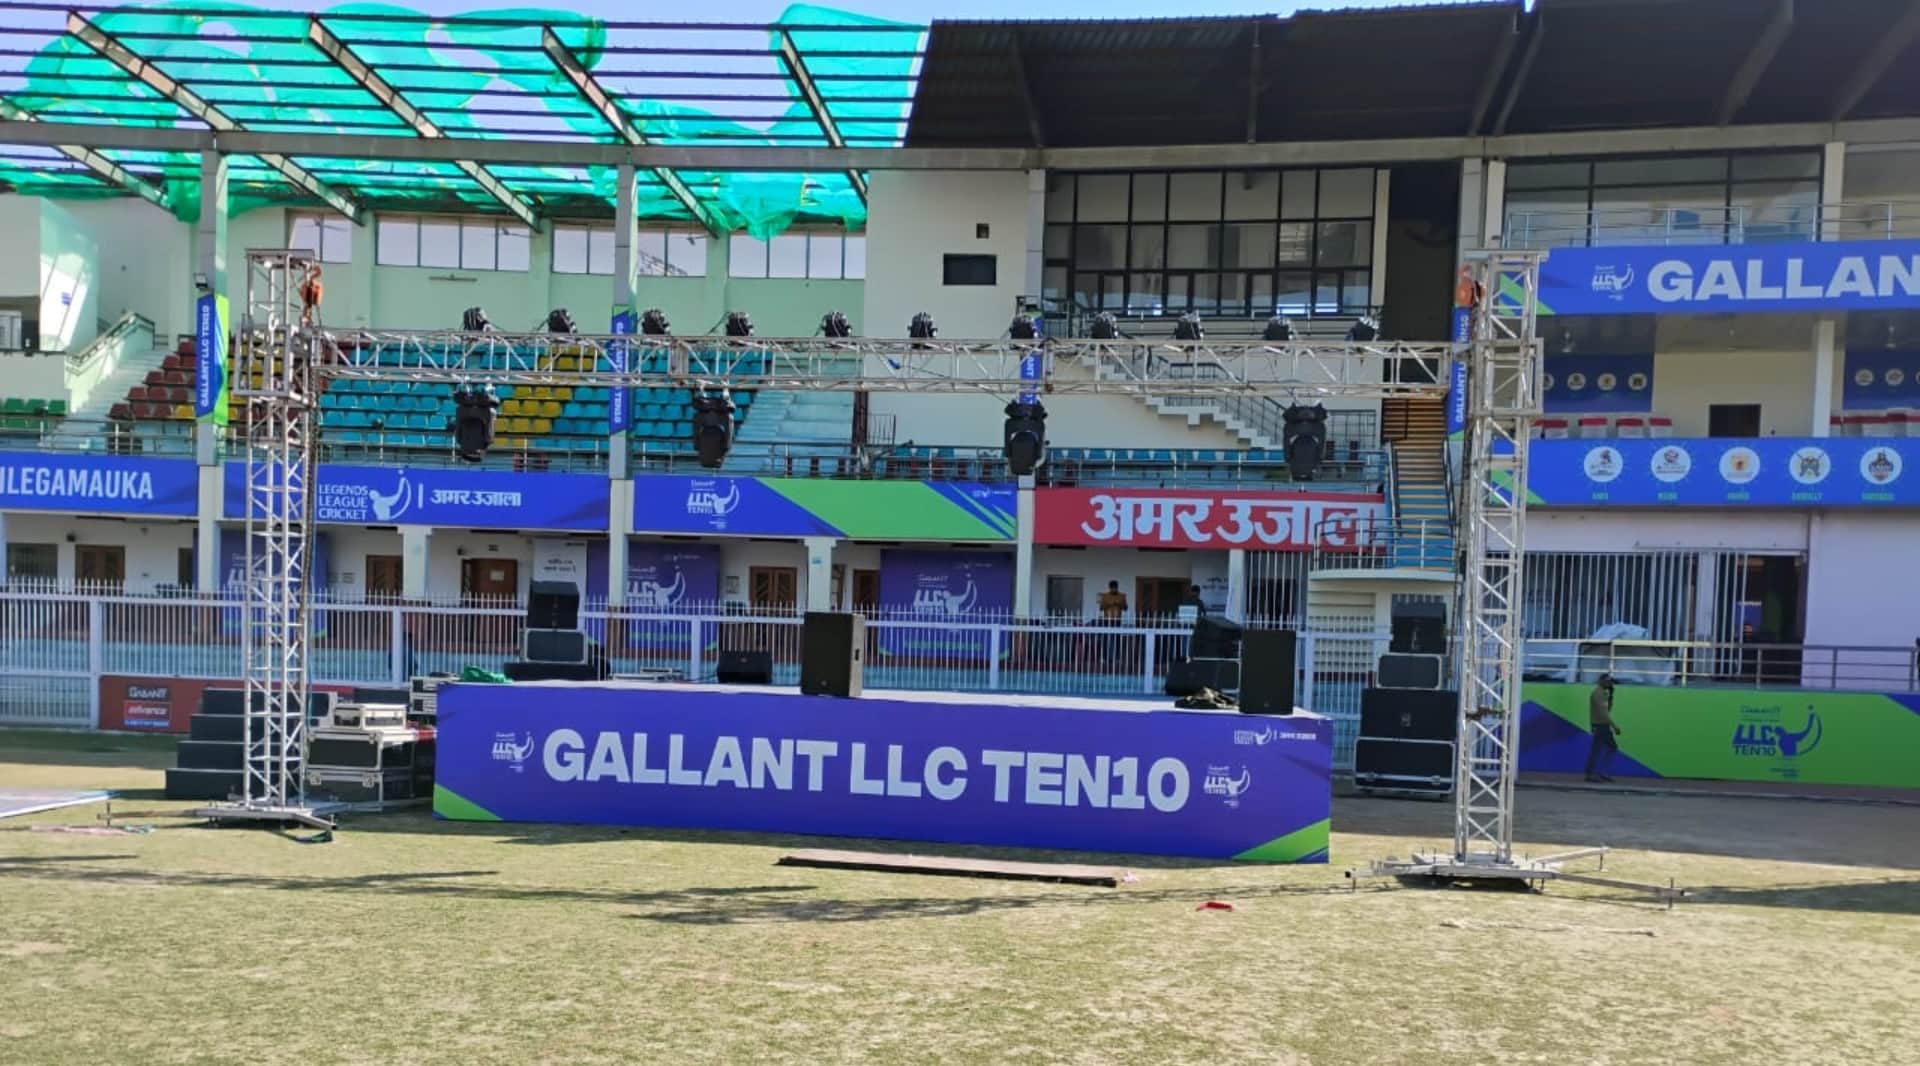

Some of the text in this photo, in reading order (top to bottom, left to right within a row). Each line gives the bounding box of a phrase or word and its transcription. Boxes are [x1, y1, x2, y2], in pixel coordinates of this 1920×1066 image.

[202, 339, 210, 359] LLC
[201, 360, 210, 407] GALLANT
[319, 484, 368, 496] LEGENDS
[431, 489, 521, 507] अमर उजाला
[319, 496, 368, 508] LEAGUE
[319, 508, 367, 520] CRICKET
[1081, 494, 1213, 542] अमर
[1732, 724, 1776, 746] LLC
[543, 728, 1190, 812] GALLANT LLC TEN10
